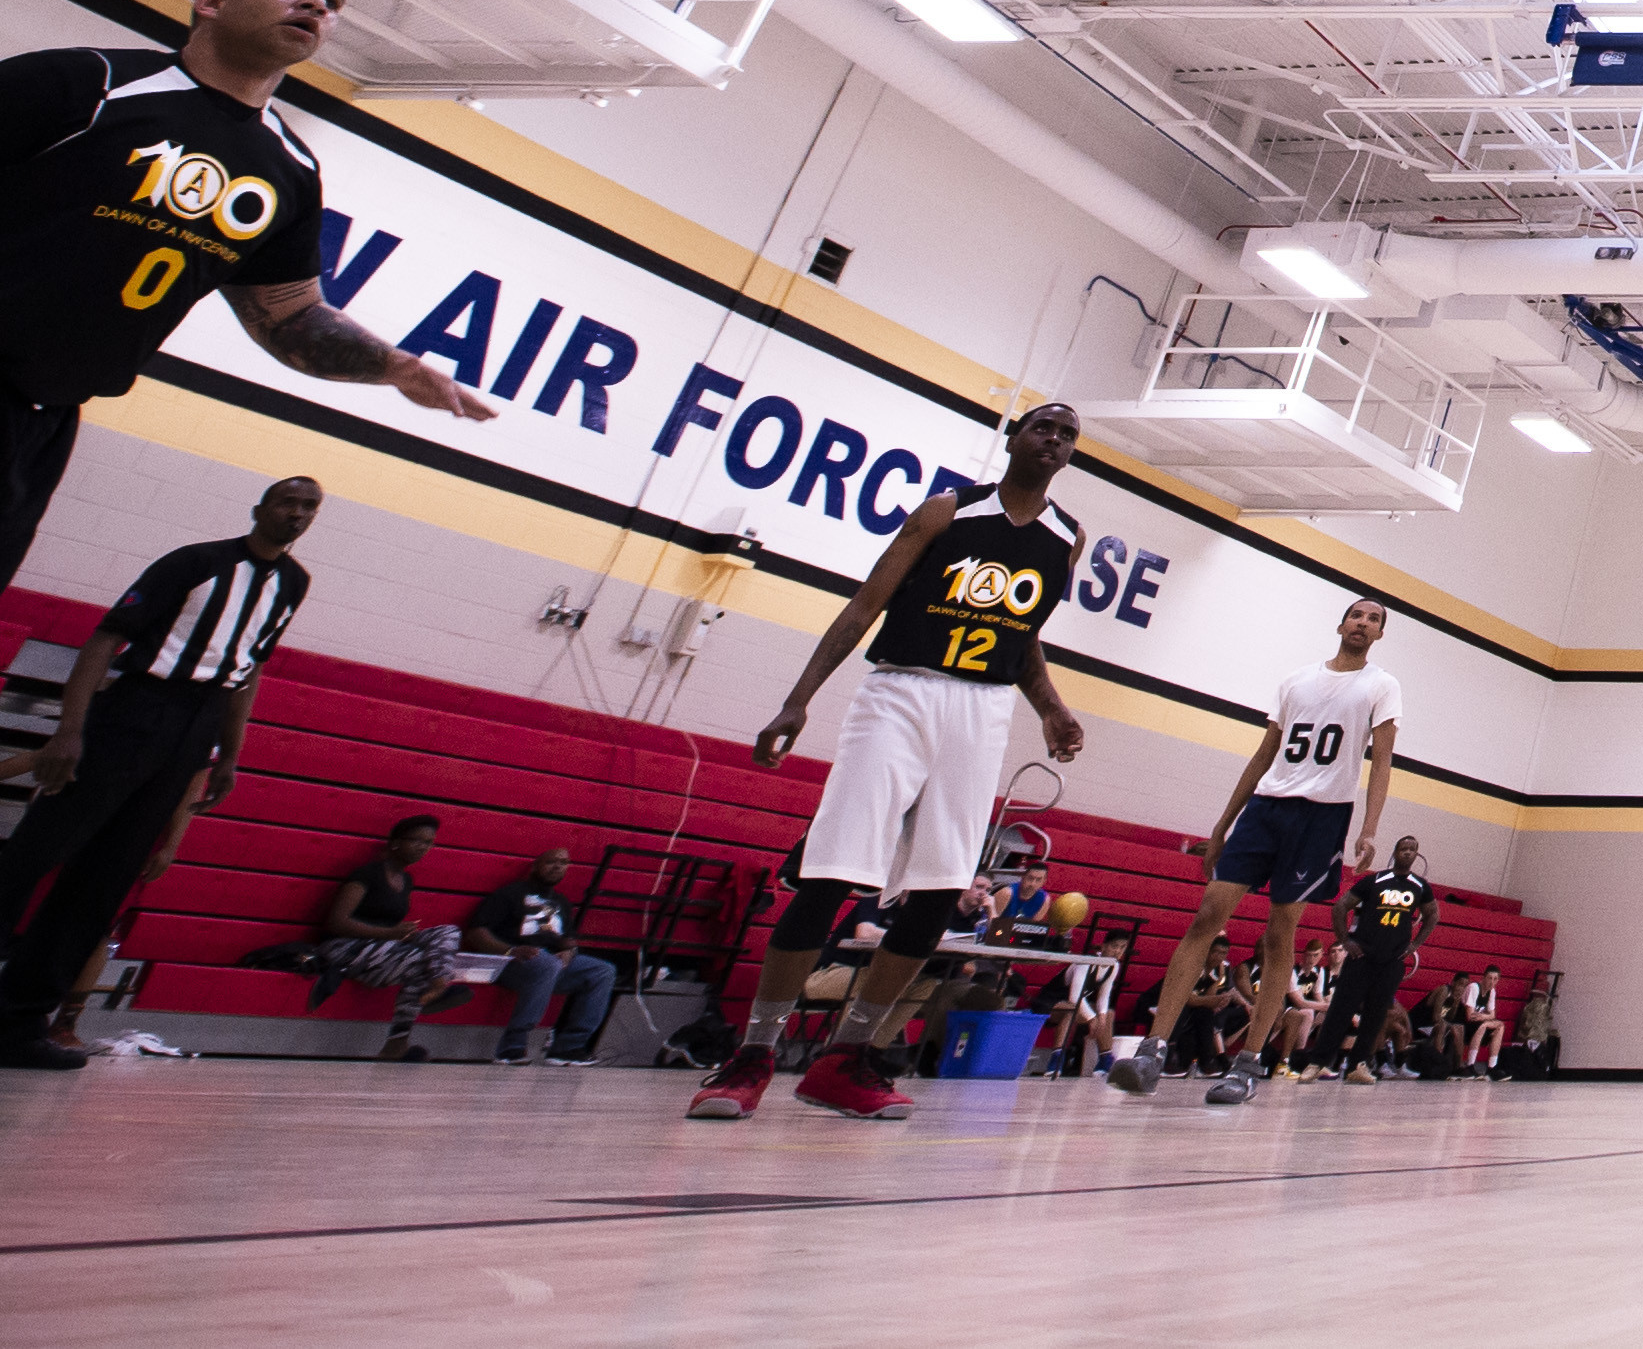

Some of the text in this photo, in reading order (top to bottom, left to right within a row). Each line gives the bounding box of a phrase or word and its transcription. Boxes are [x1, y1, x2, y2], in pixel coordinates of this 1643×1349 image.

[93, 205, 147, 226] DAWN
[147, 218, 169, 232] OF
[164, 226, 178, 237] A
[121, 247, 187, 311] 0
[398, 270, 639, 434] AIR
[942, 626, 997, 672] 12
[1284, 722, 1345, 766] 50
[1380, 911, 1400, 928] 44
